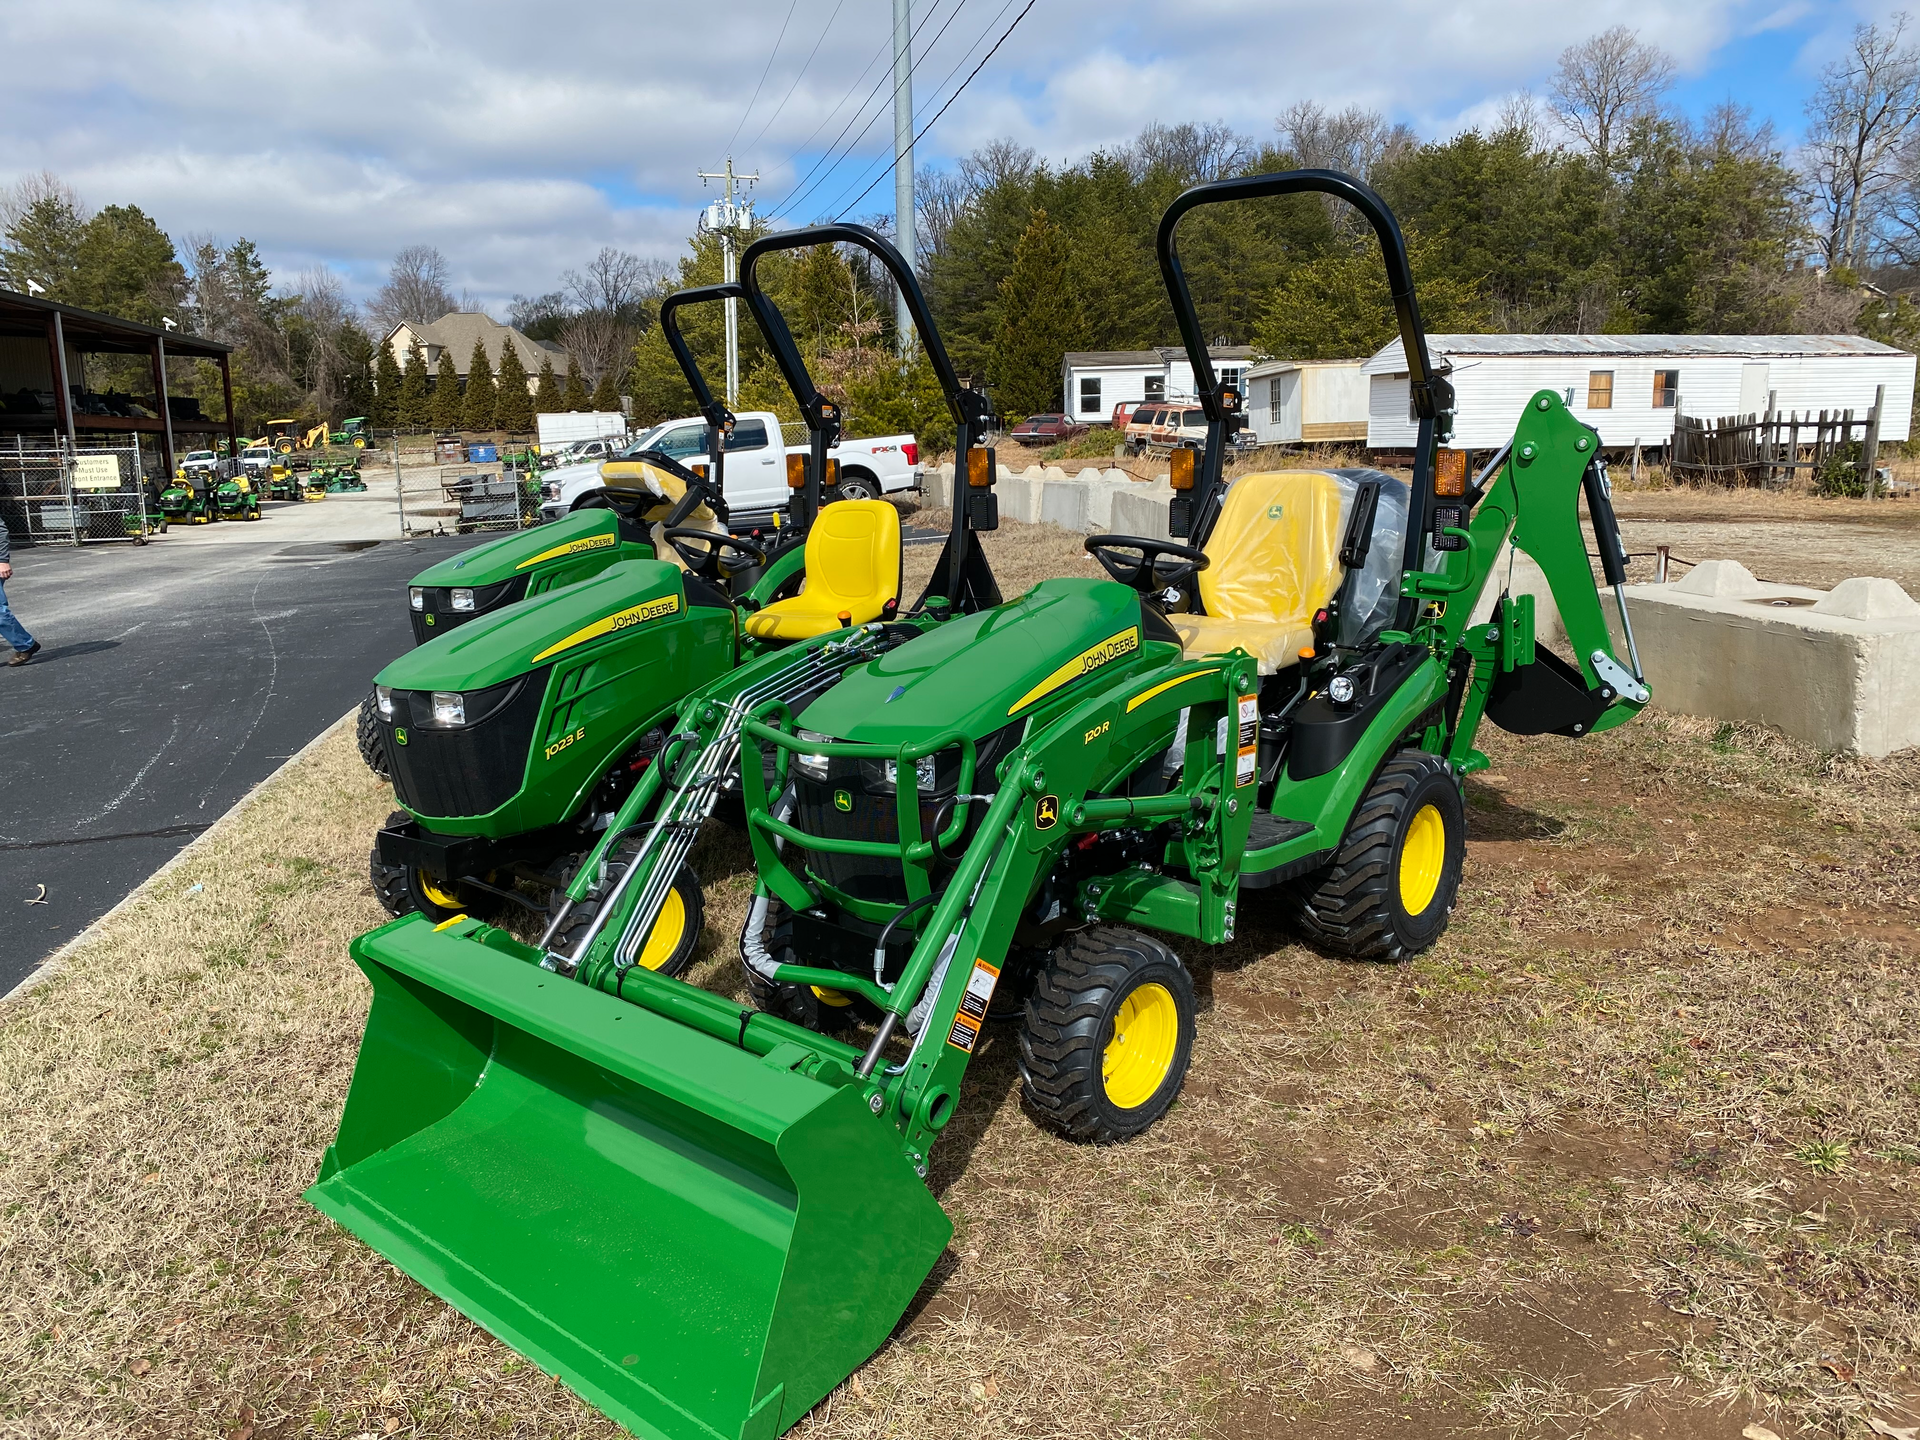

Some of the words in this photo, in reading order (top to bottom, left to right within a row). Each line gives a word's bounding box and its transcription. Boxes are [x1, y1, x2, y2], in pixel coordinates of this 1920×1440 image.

[871, 445, 898, 454] FX4
[569, 542, 589, 553] JOHN
[588, 537, 613, 548] DEERE
[611, 610, 641, 630] JOHN
[640, 601, 675, 619] DEERE
[1081, 648, 1107, 673] JOHN
[1106, 635, 1136, 659] DEERE
[544, 734, 574, 761] 1023
[576, 726, 585, 741] E
[1084, 725, 1102, 746] 120
[1101, 720, 1110, 734] R
